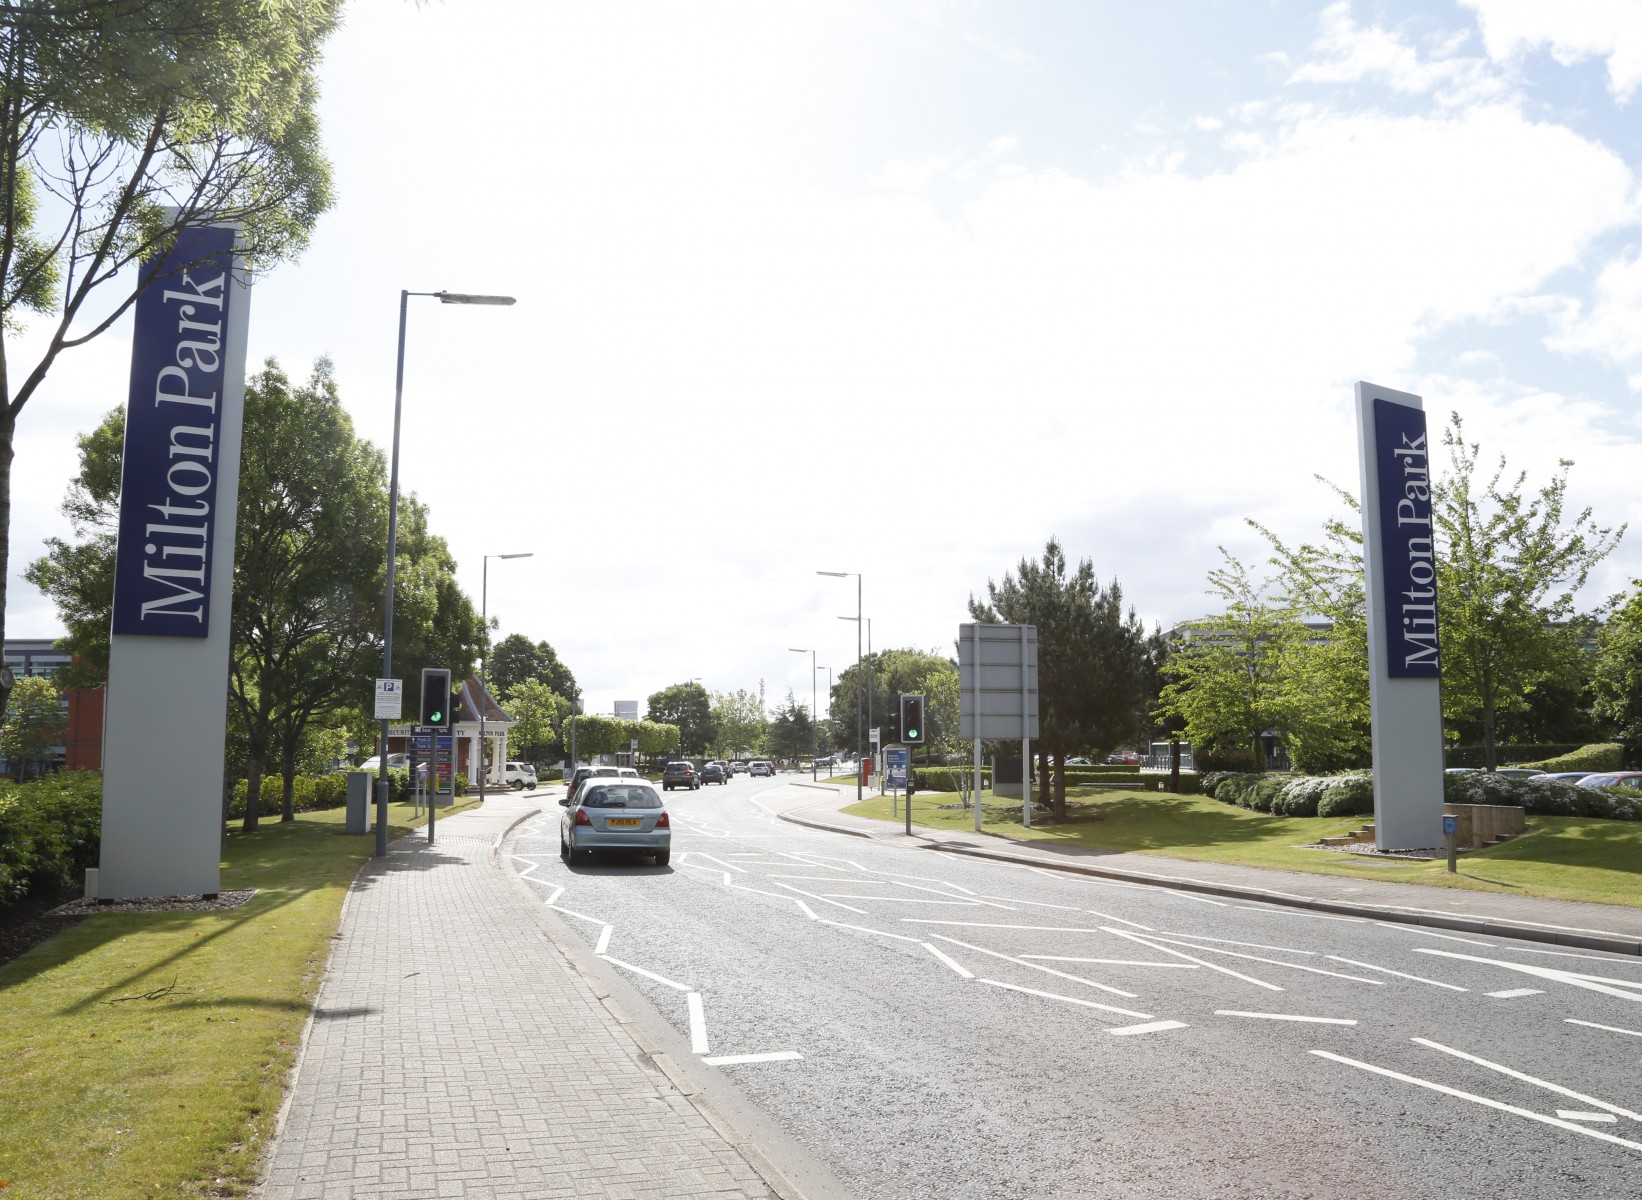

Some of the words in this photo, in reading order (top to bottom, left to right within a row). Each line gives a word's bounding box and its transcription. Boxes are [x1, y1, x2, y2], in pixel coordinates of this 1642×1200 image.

[155, 268, 226, 415] Park
[140, 422, 214, 623] Milton
[1394, 431, 1431, 528] Park
[1402, 534, 1439, 669] Milton
